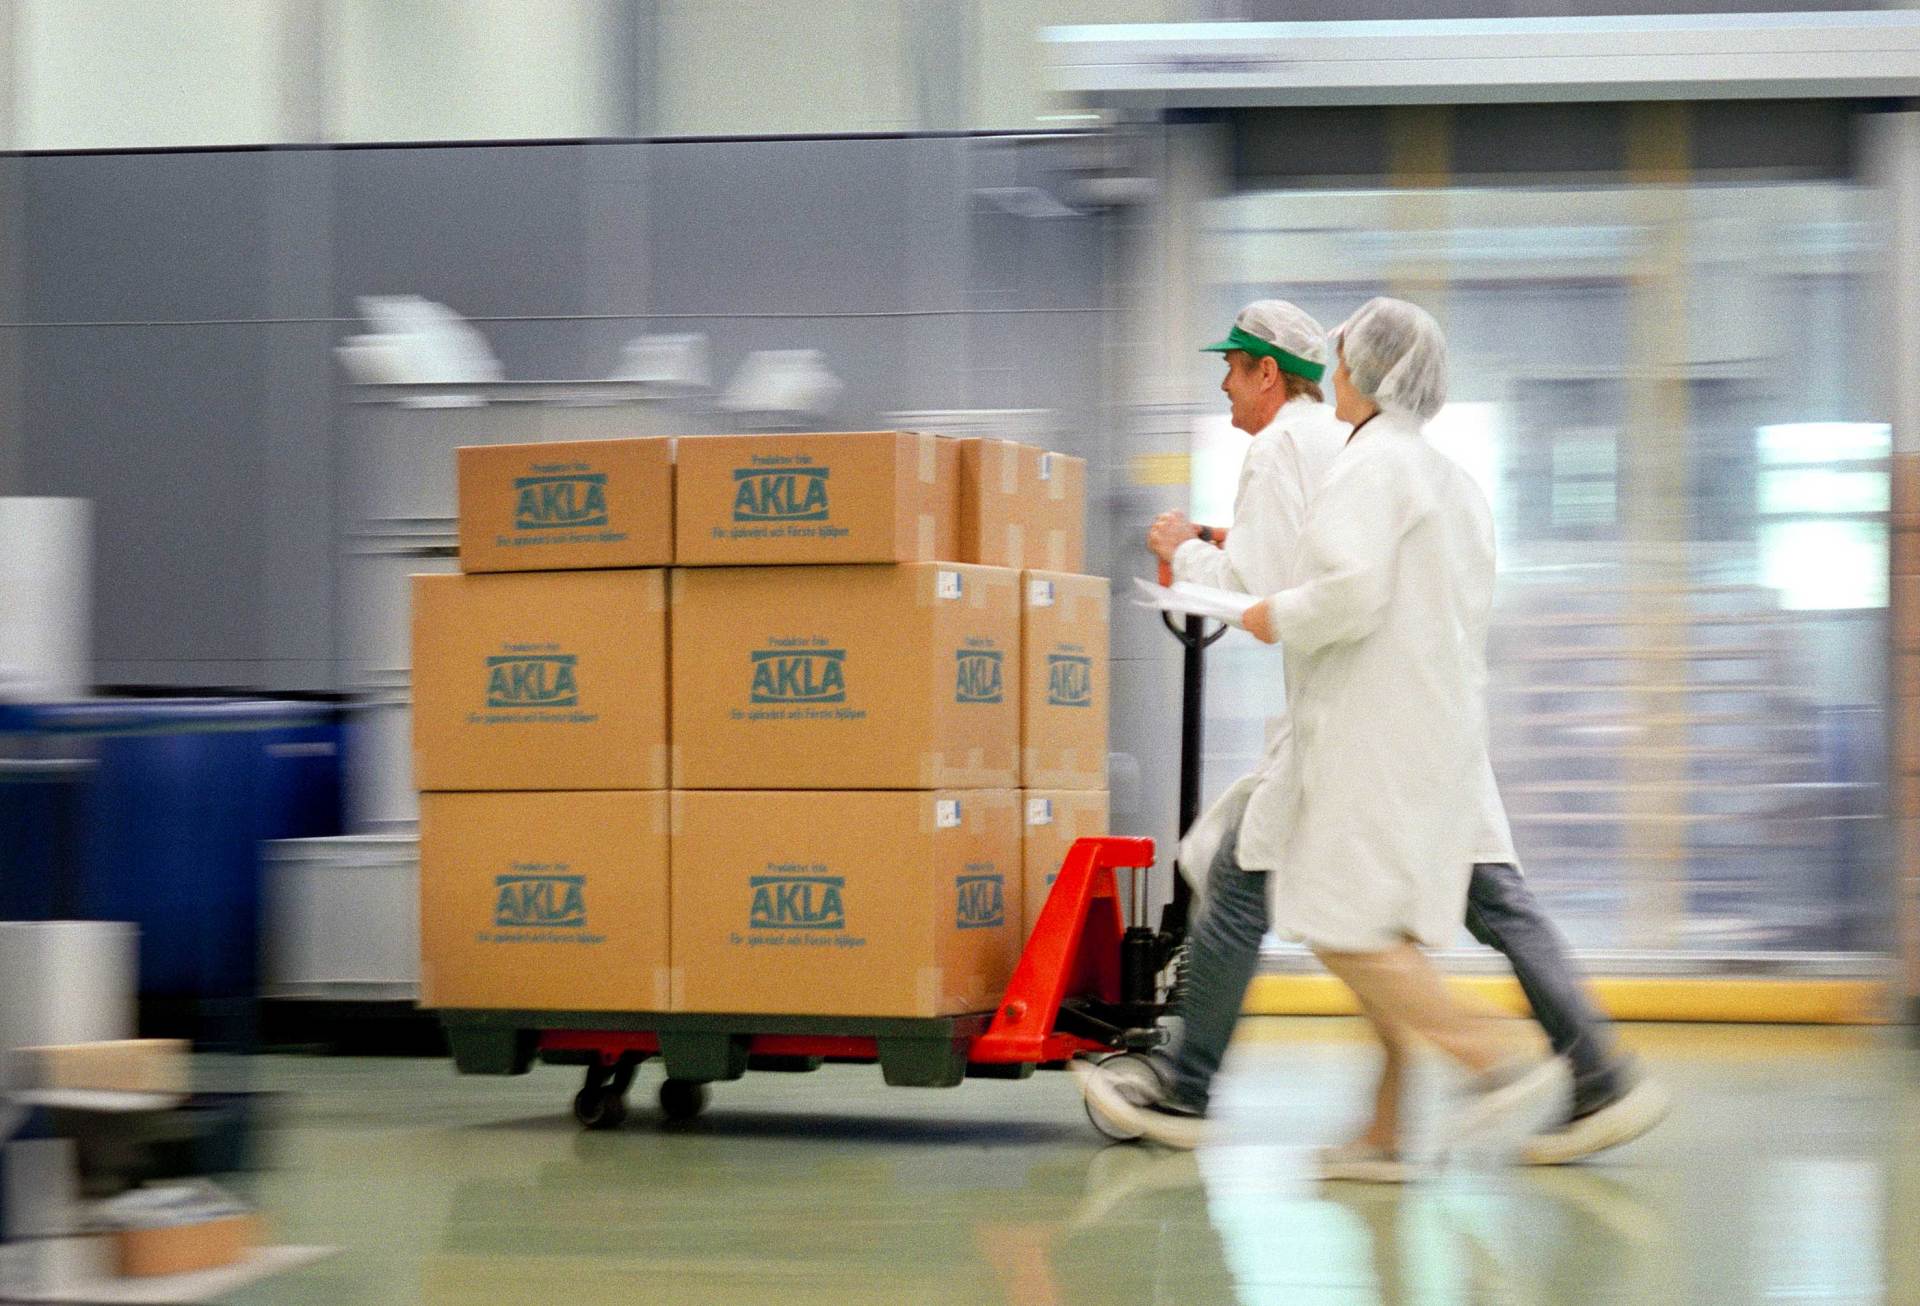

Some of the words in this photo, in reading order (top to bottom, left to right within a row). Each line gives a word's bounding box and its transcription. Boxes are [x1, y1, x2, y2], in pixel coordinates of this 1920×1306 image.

[515, 483, 606, 520] AKLA
[735, 475, 828, 514] AKLA
[486, 662, 577, 700] AKLA
[752, 657, 845, 695] AKLA
[957, 658, 1002, 696] AKLA
[1049, 662, 1091, 699] AKLA
[496, 881, 586, 919] AKLA
[751, 884, 845, 921] AKLA
[957, 881, 1003, 921] AKLA
